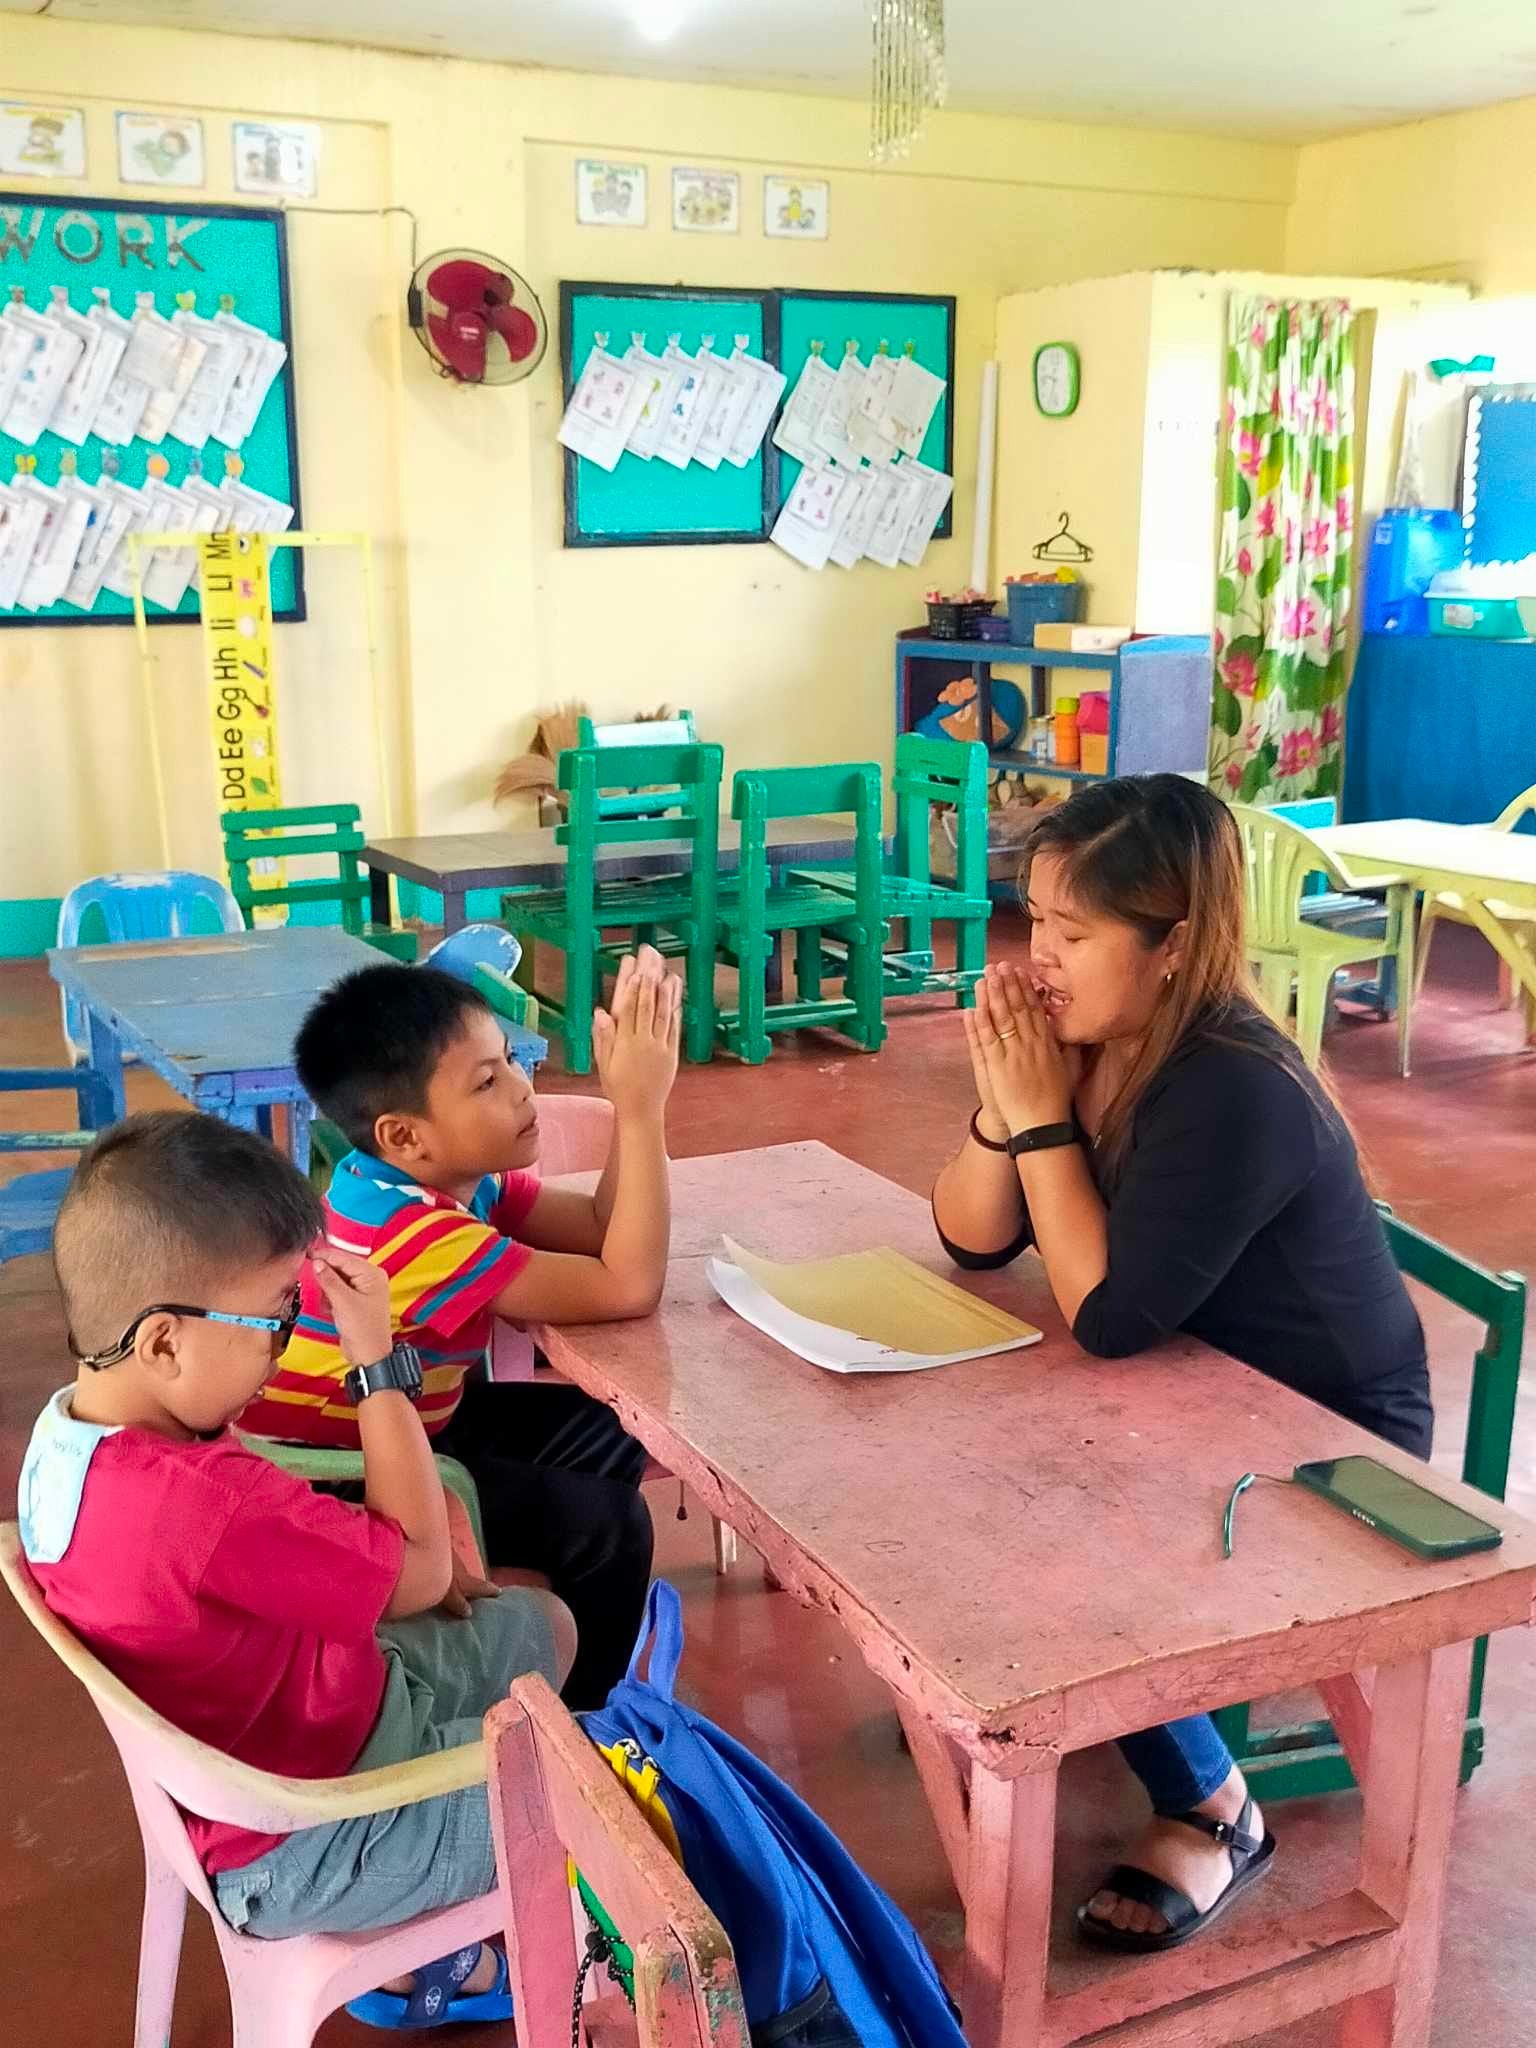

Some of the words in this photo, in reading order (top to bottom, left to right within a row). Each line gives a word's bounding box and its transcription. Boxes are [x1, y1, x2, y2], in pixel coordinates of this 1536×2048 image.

[0, 206, 210, 272] WORK
[206, 574, 233, 592] Ll
[213, 646, 239, 680] Hh
[216, 687, 248, 721] Gg
[219, 727, 243, 760] Ee
[220, 766, 246, 800] Dd
